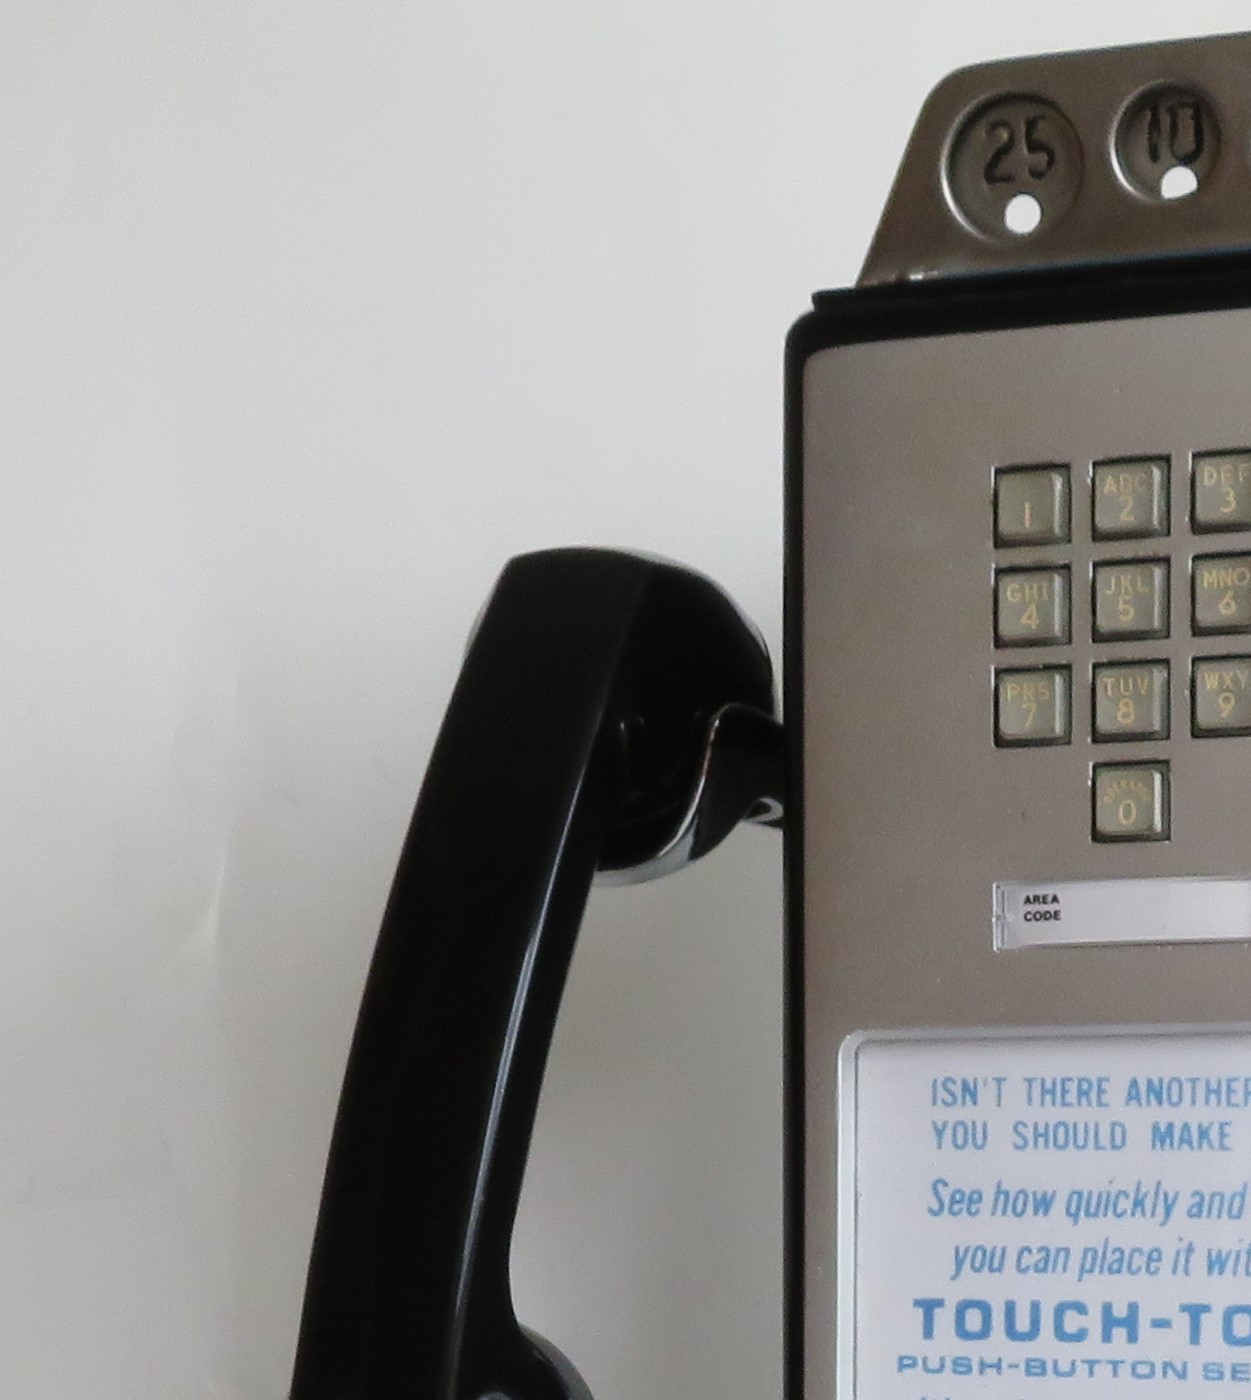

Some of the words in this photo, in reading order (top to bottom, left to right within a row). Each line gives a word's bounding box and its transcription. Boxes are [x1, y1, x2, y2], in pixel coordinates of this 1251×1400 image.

[1148, 101, 1204, 164] 10
[983, 114, 1056, 185] 25
[1103, 474, 1147, 495] ABC
[1203, 464, 1249, 487] DEF
[1119, 497, 1135, 521] 2
[1219, 487, 1237, 513] 3
[1023, 502, 1032, 528] 1
[1106, 573, 1149, 596] JKL
[1202, 566, 1250, 589] MNO
[1006, 583, 1050, 604] GHI
[1218, 592, 1237, 615] 6
[1019, 604, 1040, 629] 4
[1118, 595, 1136, 622] 5
[1103, 676, 1149, 696] TUV
[1204, 671, 1249, 690] WXY
[1021, 702, 1037, 728] 7
[1117, 698, 1136, 725] 8
[1217, 692, 1236, 718] 9
[1023, 893, 1060, 905] AREA
[1023, 909, 1062, 922] CODE
[931, 1076, 1007, 1107] ISN'T
[1023, 1076, 1110, 1107] THERE
[931, 1120, 988, 1151] YOU
[1012, 1120, 1128, 1151] SHOULD
[1151, 1120, 1233, 1151] MAKE
[927, 1177, 983, 1217] See
[991, 1179, 1057, 1217] how
[1064, 1178, 1179, 1227] quickly
[1186, 1181, 1250, 1220] and
[950, 1244, 1007, 1282] you
[1015, 1245, 1071, 1275] can
[1074, 1236, 1163, 1282] place
[1170, 1236, 1196, 1277] it
[896, 1355, 1189, 1382] PUSH-BUTTON
